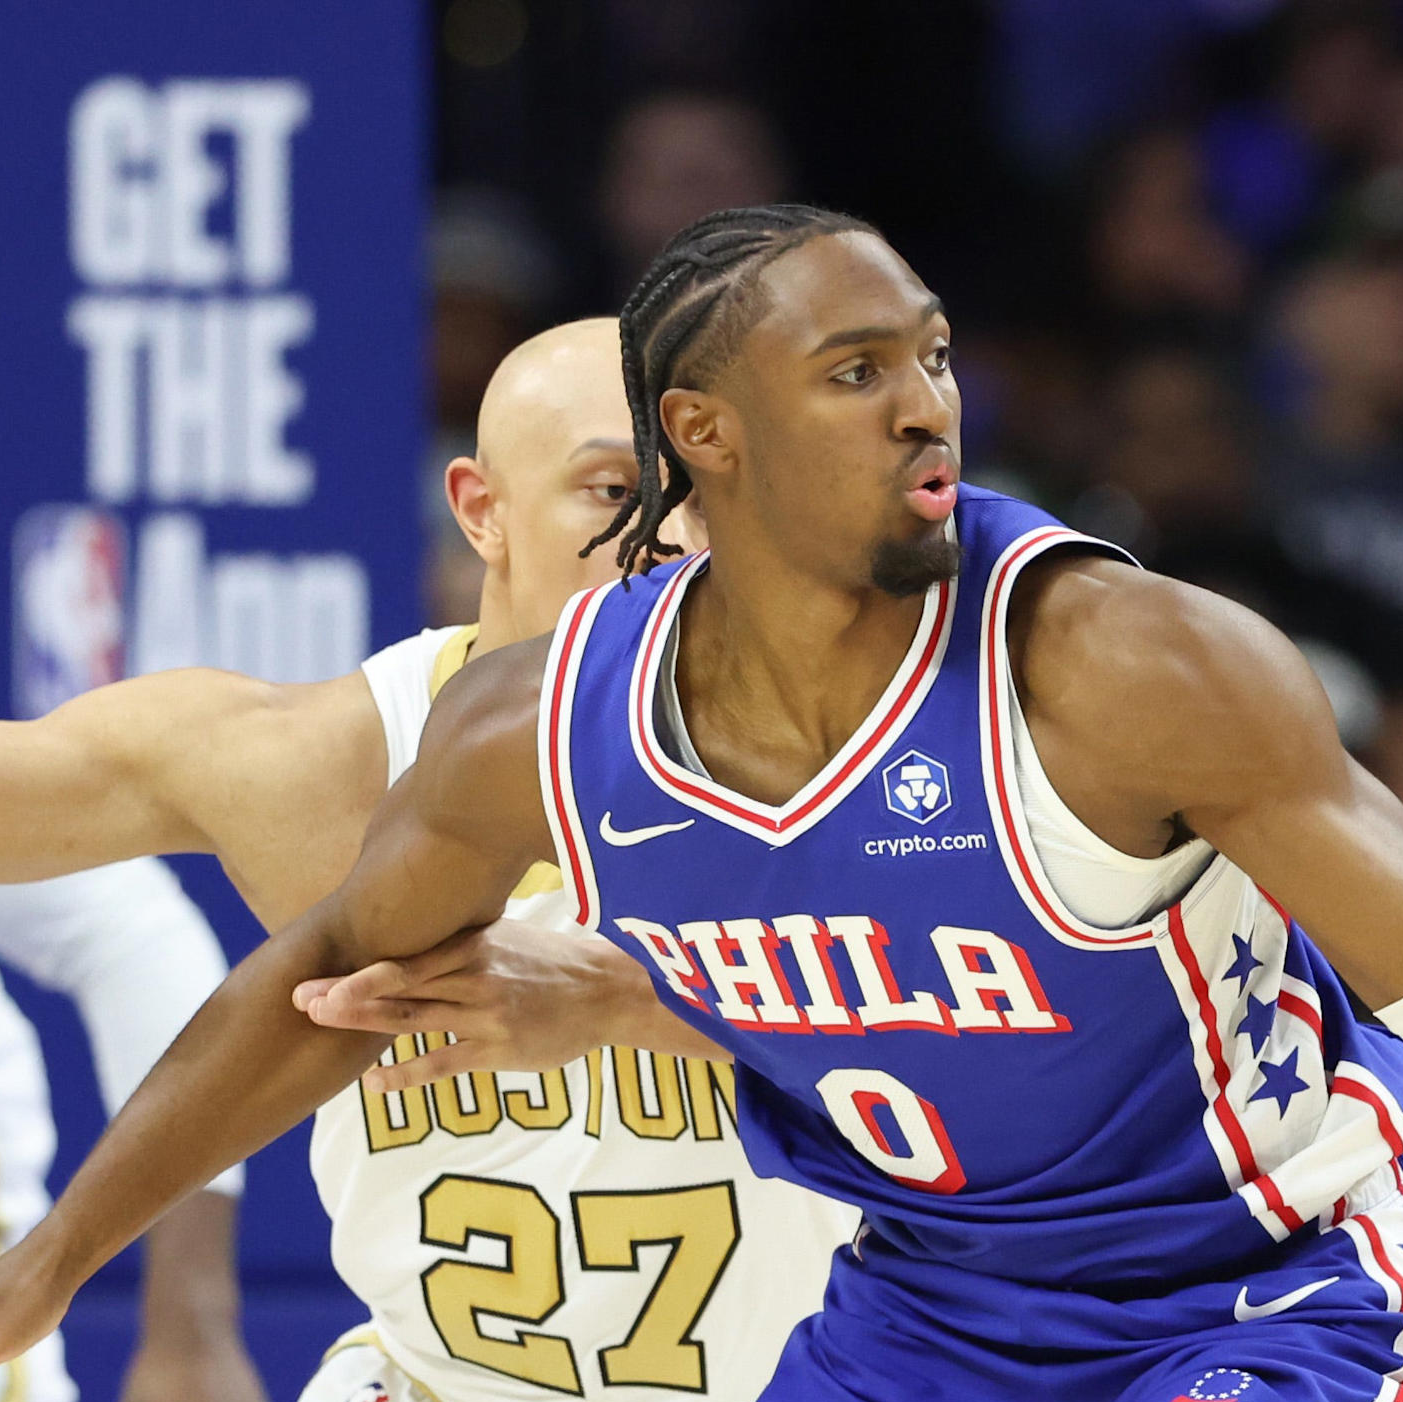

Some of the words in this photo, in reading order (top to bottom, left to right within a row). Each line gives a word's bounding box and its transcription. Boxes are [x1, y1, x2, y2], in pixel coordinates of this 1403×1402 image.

[66, 75, 313, 290] GET
[64, 296, 316, 503] THE
[864, 833, 987, 857] crypto.com
[614, 912, 1073, 1037] PHILA
[814, 1067, 967, 1195] 0
[419, 1173, 741, 1399] 27
